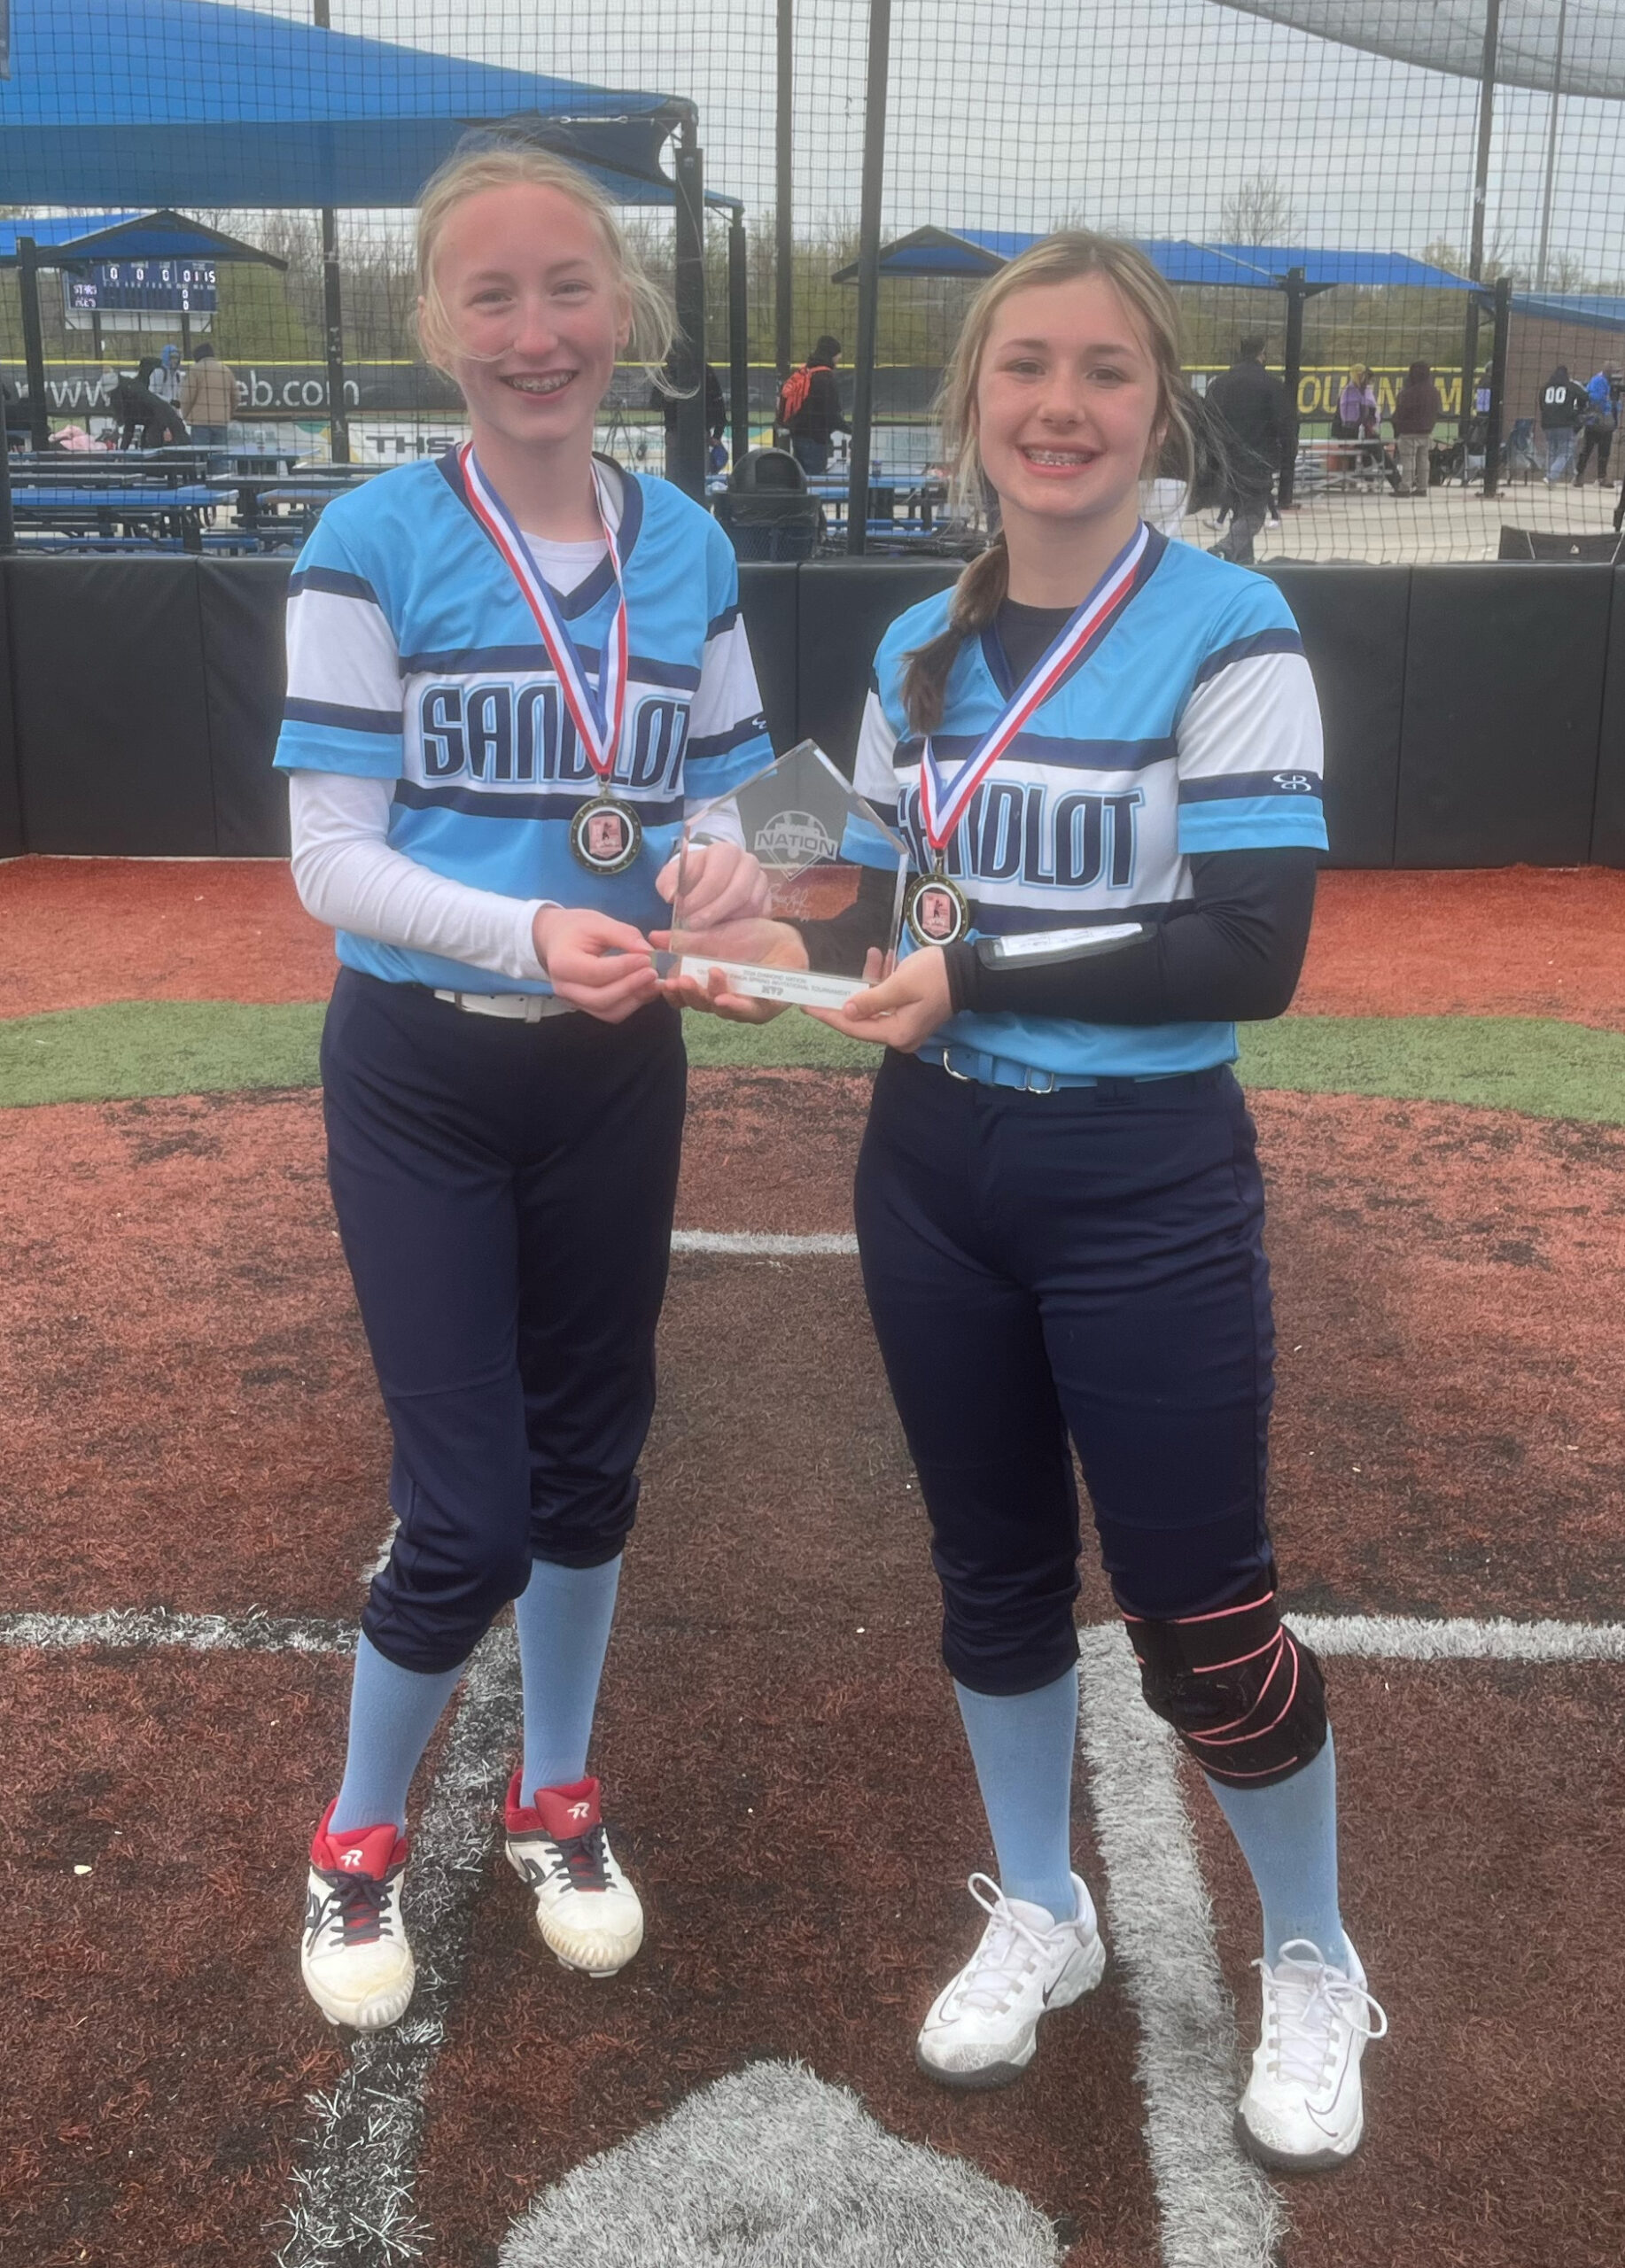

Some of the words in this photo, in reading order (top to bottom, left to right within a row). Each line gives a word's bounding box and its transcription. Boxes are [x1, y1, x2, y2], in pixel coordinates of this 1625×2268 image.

[1544, 386, 1567, 403] 00
[419, 680, 691, 795] SANDOT
[758, 832, 836, 858] NATION
